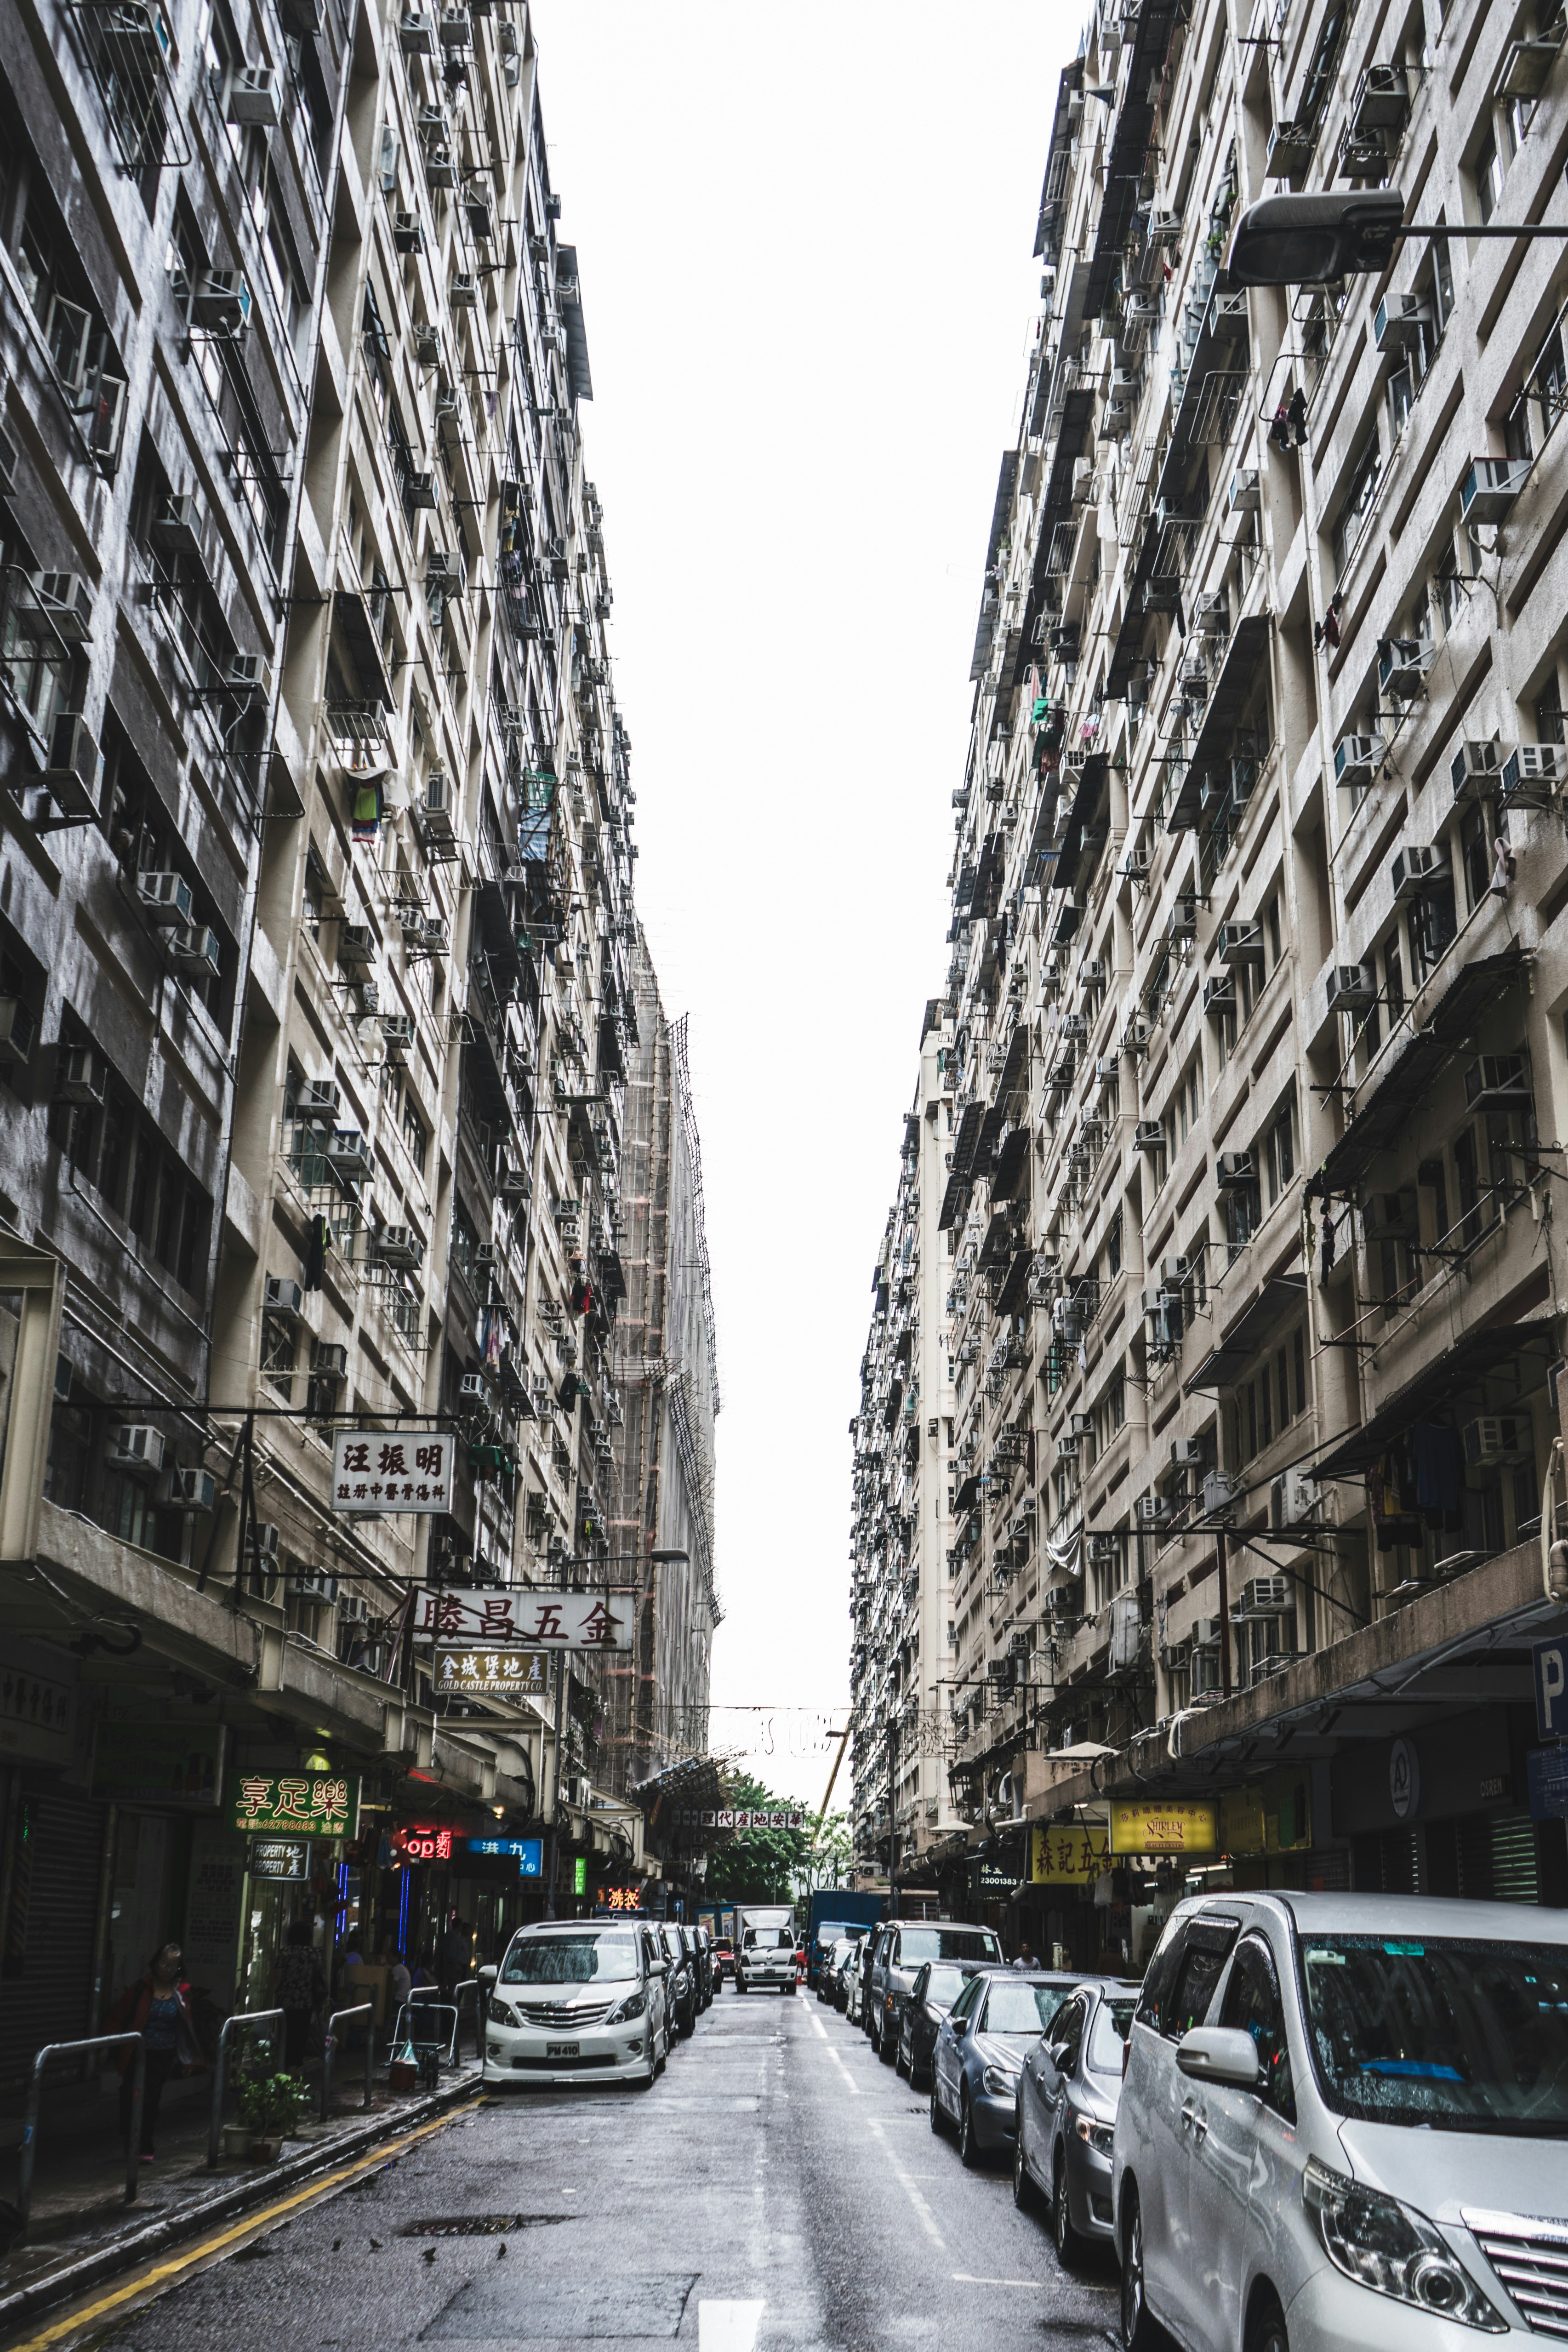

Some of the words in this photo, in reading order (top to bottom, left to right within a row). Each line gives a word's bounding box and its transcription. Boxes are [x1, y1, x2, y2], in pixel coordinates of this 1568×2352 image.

[343, 1443, 443, 1478] 汪振明
[420, 1593, 624, 1645] 勝昌五金
[439, 1654, 543, 1680] 金城堡地產
[438, 1680, 459, 1690] GOLD
[460, 1680, 489, 1690] CASTLE
[490, 1680, 530, 1691] PROPERTY
[530, 1681, 543, 1691] CO.
[1541, 1649, 1564, 1729] P
[236, 1775, 348, 1820] 享足樂
[256, 1844, 286, 1858] PROPERTY
[255, 1861, 285, 1873] PROPERTY
[611, 1890, 637, 1907] 洗衣
[548, 2046, 561, 2056] PM
[562, 2045, 578, 2055] 410
